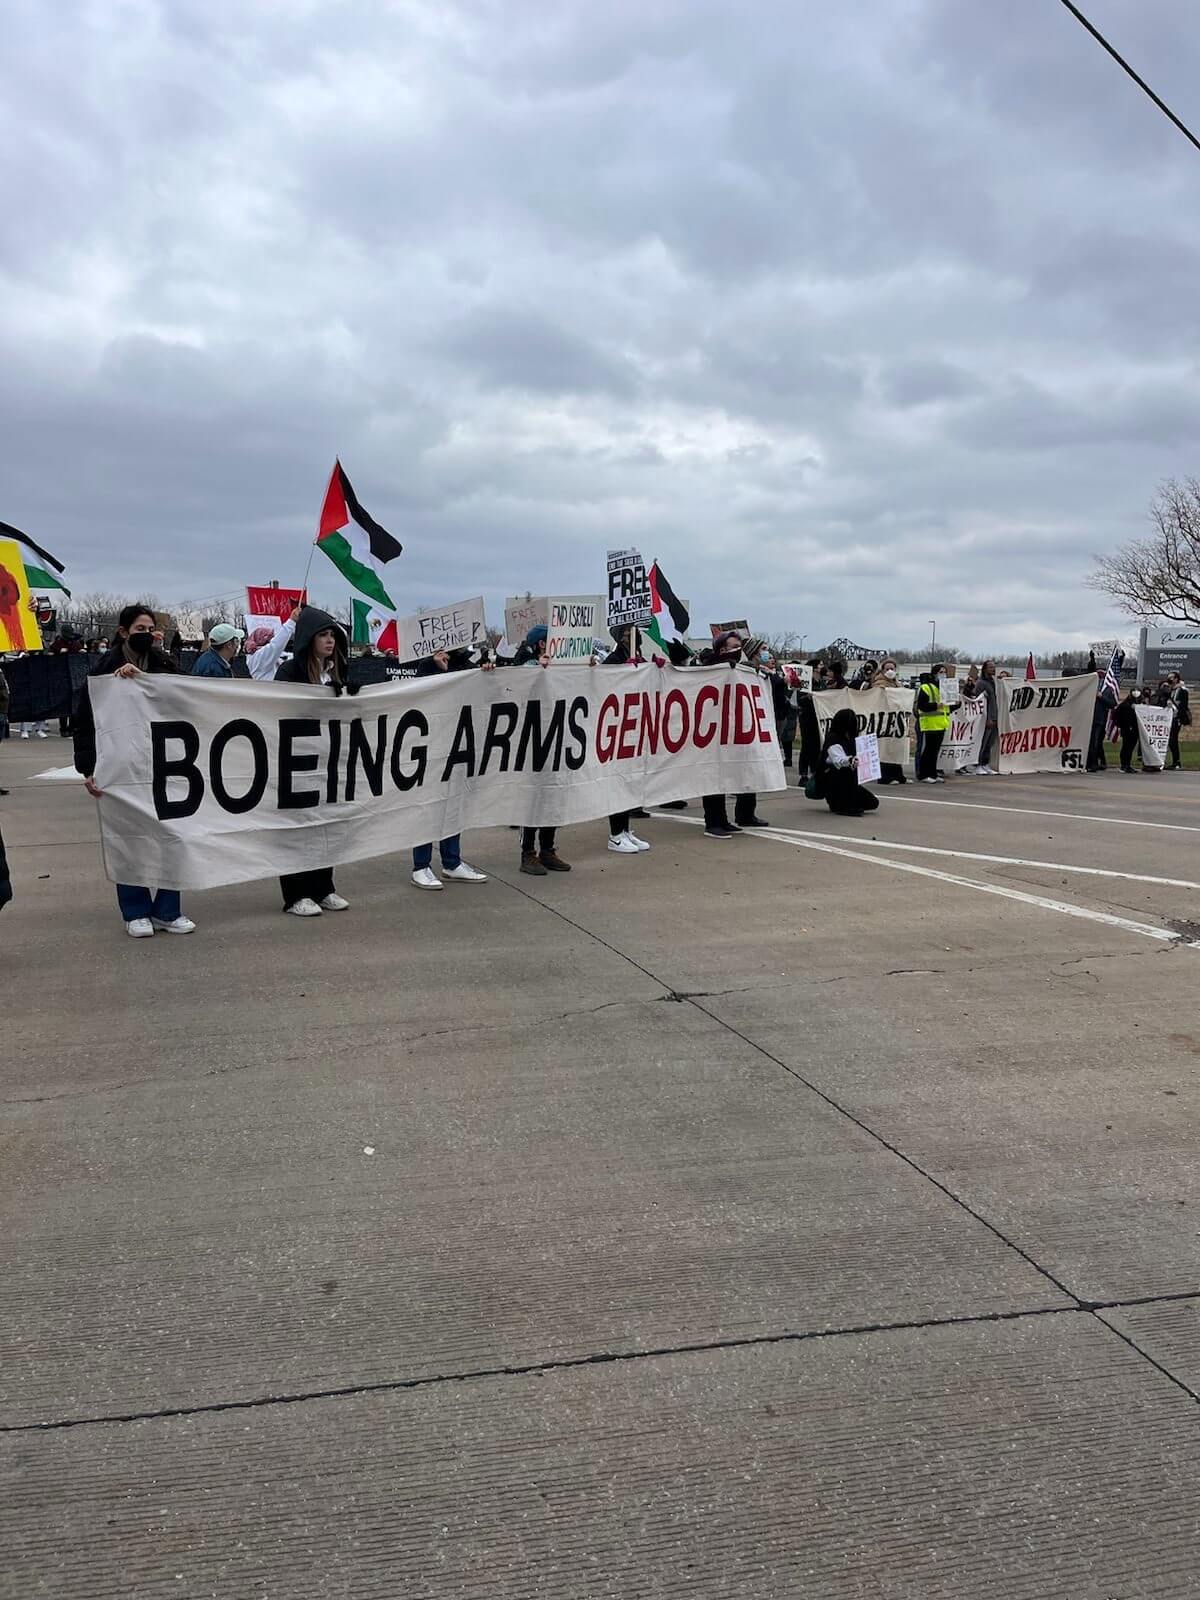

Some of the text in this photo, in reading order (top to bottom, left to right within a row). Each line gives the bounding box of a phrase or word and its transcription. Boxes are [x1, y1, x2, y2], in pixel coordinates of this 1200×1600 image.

[609, 566, 650, 601] FREE
[551, 605, 567, 627] END
[569, 605, 594, 628] ISRAELI
[609, 594, 651, 616] PALESTINE
[419, 610, 464, 637] FREE
[549, 637, 592, 659] OCCUPATION
[1009, 686, 1069, 713] END THE
[150, 708, 430, 821] BOEING
[439, 696, 589, 782] ARMS
[595, 683, 772, 764] GENOCIDE
[1061, 749, 1085, 769] PSL
